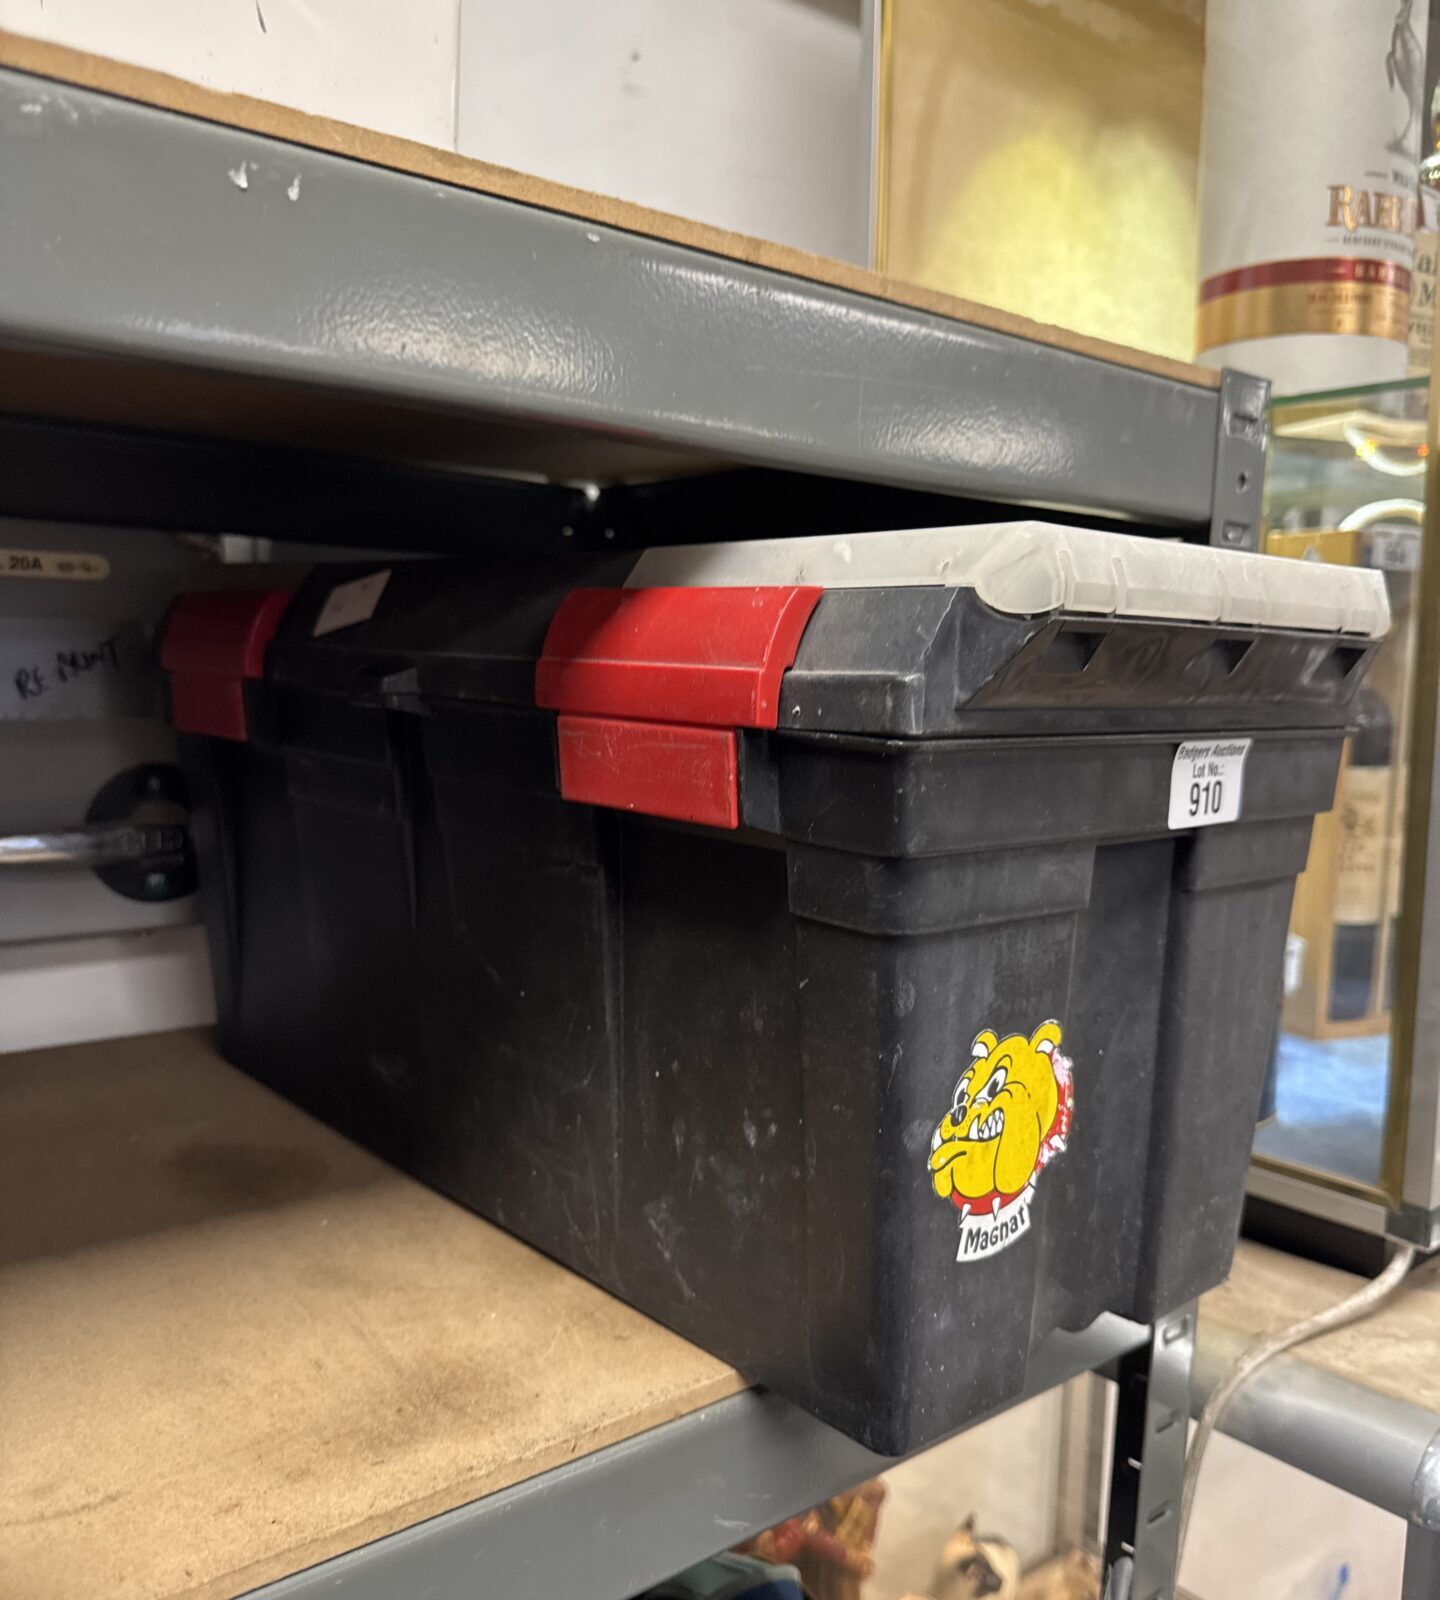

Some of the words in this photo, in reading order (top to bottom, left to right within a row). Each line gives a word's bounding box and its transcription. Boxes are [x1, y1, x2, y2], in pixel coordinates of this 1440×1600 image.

[1211, 743, 1246, 758] Auctions
[1192, 762, 1206, 778] Lot
[1189, 780, 1223, 816] 910
